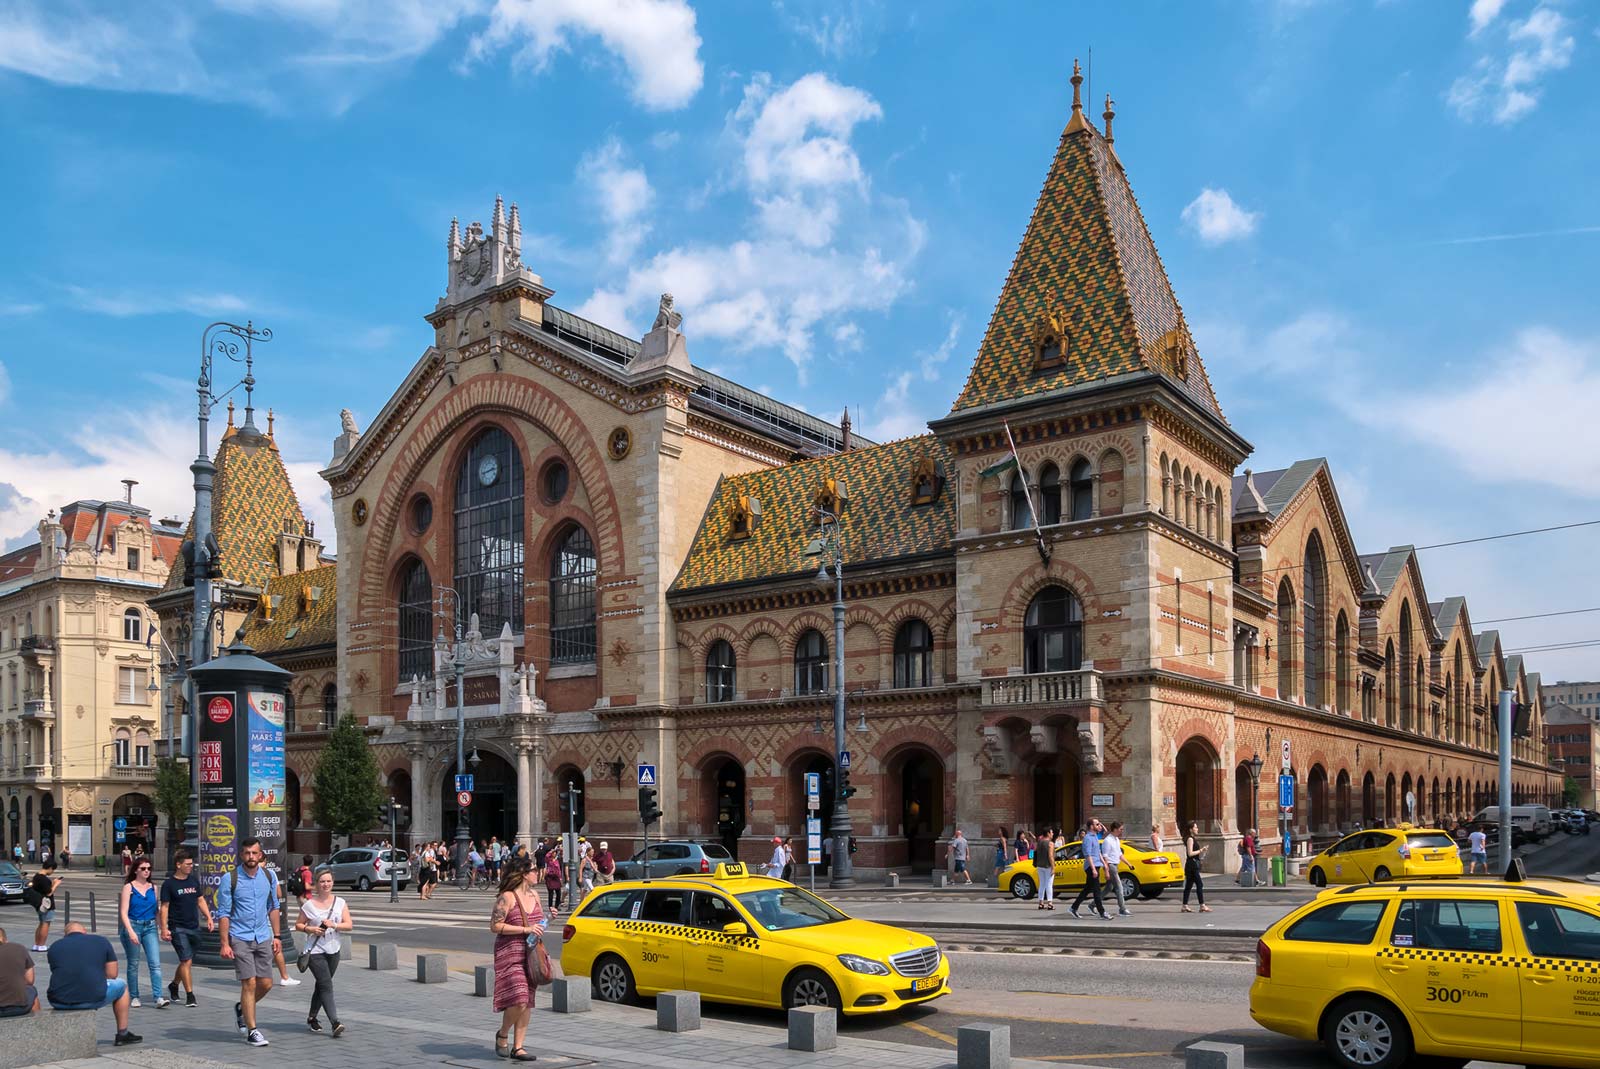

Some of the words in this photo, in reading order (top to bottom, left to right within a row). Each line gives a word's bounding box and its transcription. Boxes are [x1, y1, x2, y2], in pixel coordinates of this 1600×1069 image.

[200, 756, 220, 768] FOK
[726, 865, 741, 873] TAXI
[642, 952, 658, 963] 300
[1426, 986, 1463, 1004] 300
[1463, 989, 1489, 999] Ft/km
